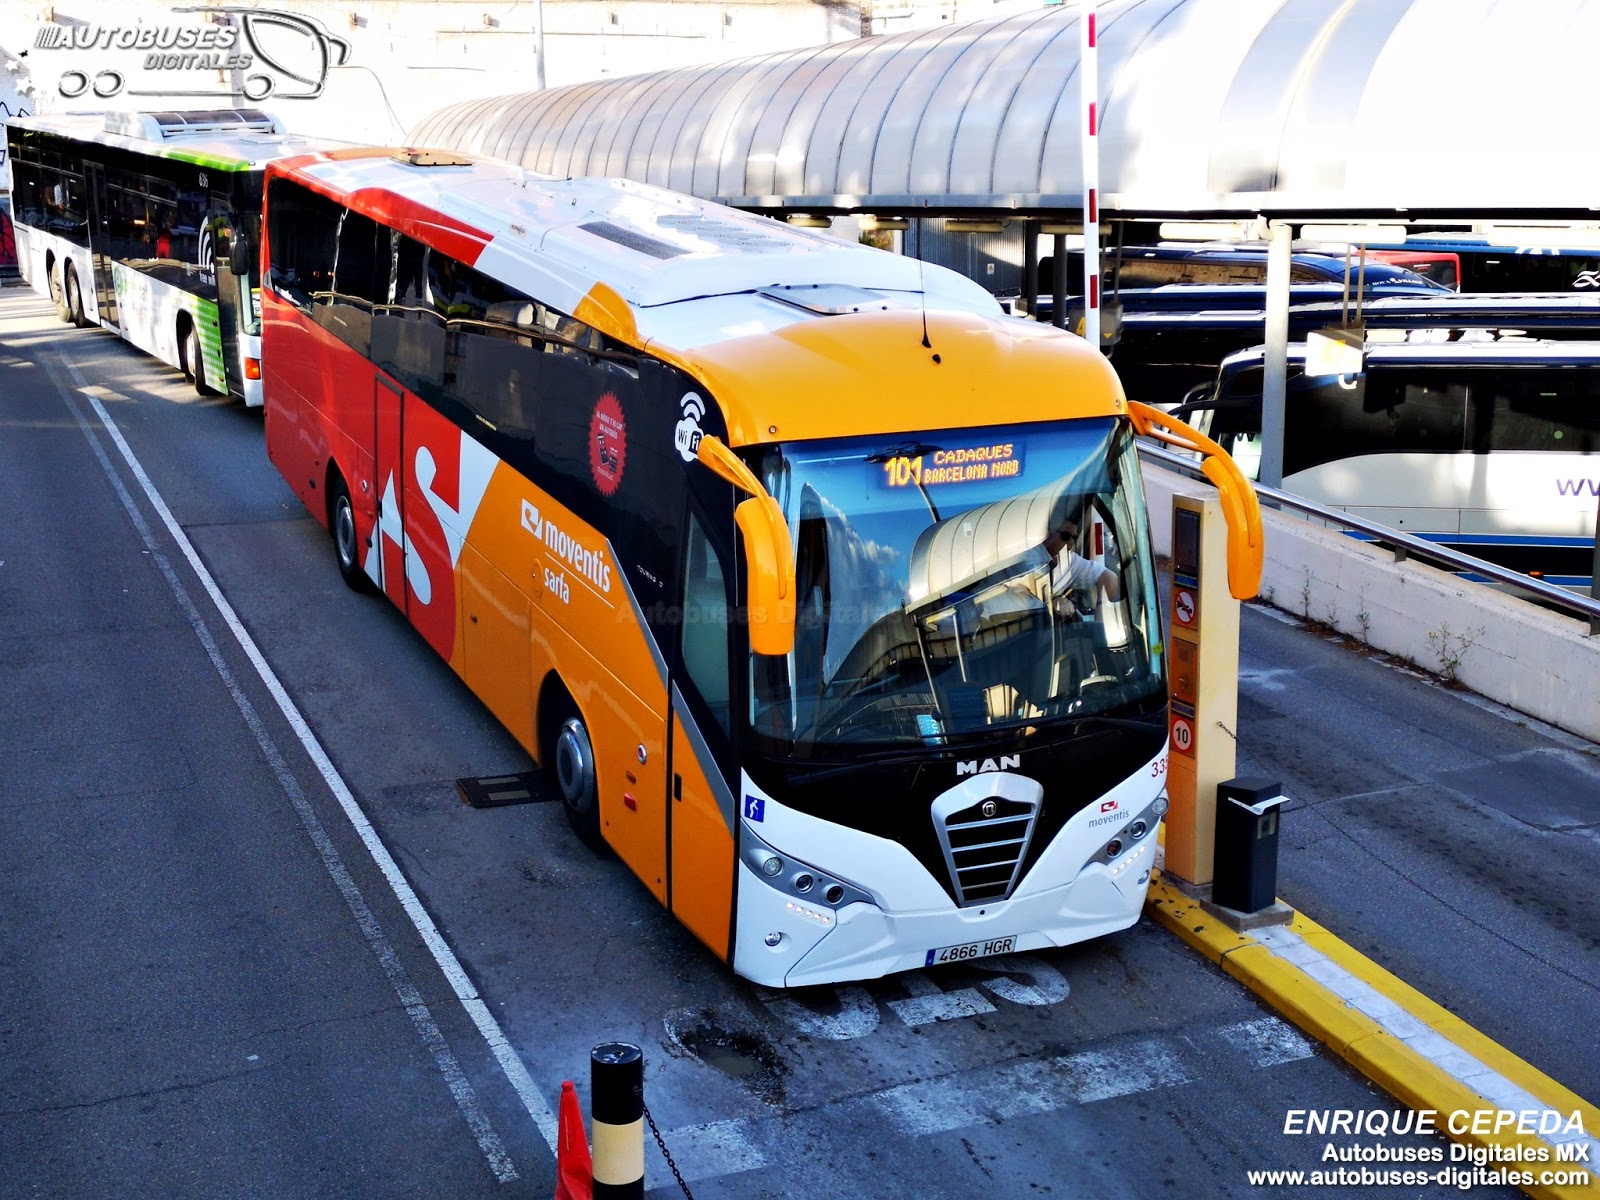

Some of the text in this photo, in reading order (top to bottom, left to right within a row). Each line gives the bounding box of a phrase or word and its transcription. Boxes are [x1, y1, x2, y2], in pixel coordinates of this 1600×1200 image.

[933, 443, 1014, 465] CADAQUES
[884, 456, 923, 487] 101
[924, 459, 1020, 484] BARCELONA NORD
[545, 520, 611, 593] moventis
[544, 567, 570, 604] sarfa
[1175, 726, 1189, 745] 10
[956, 754, 1021, 776] MAN
[1088, 809, 1130, 828] moventis
[939, 938, 1013, 962] 4866 HGR
